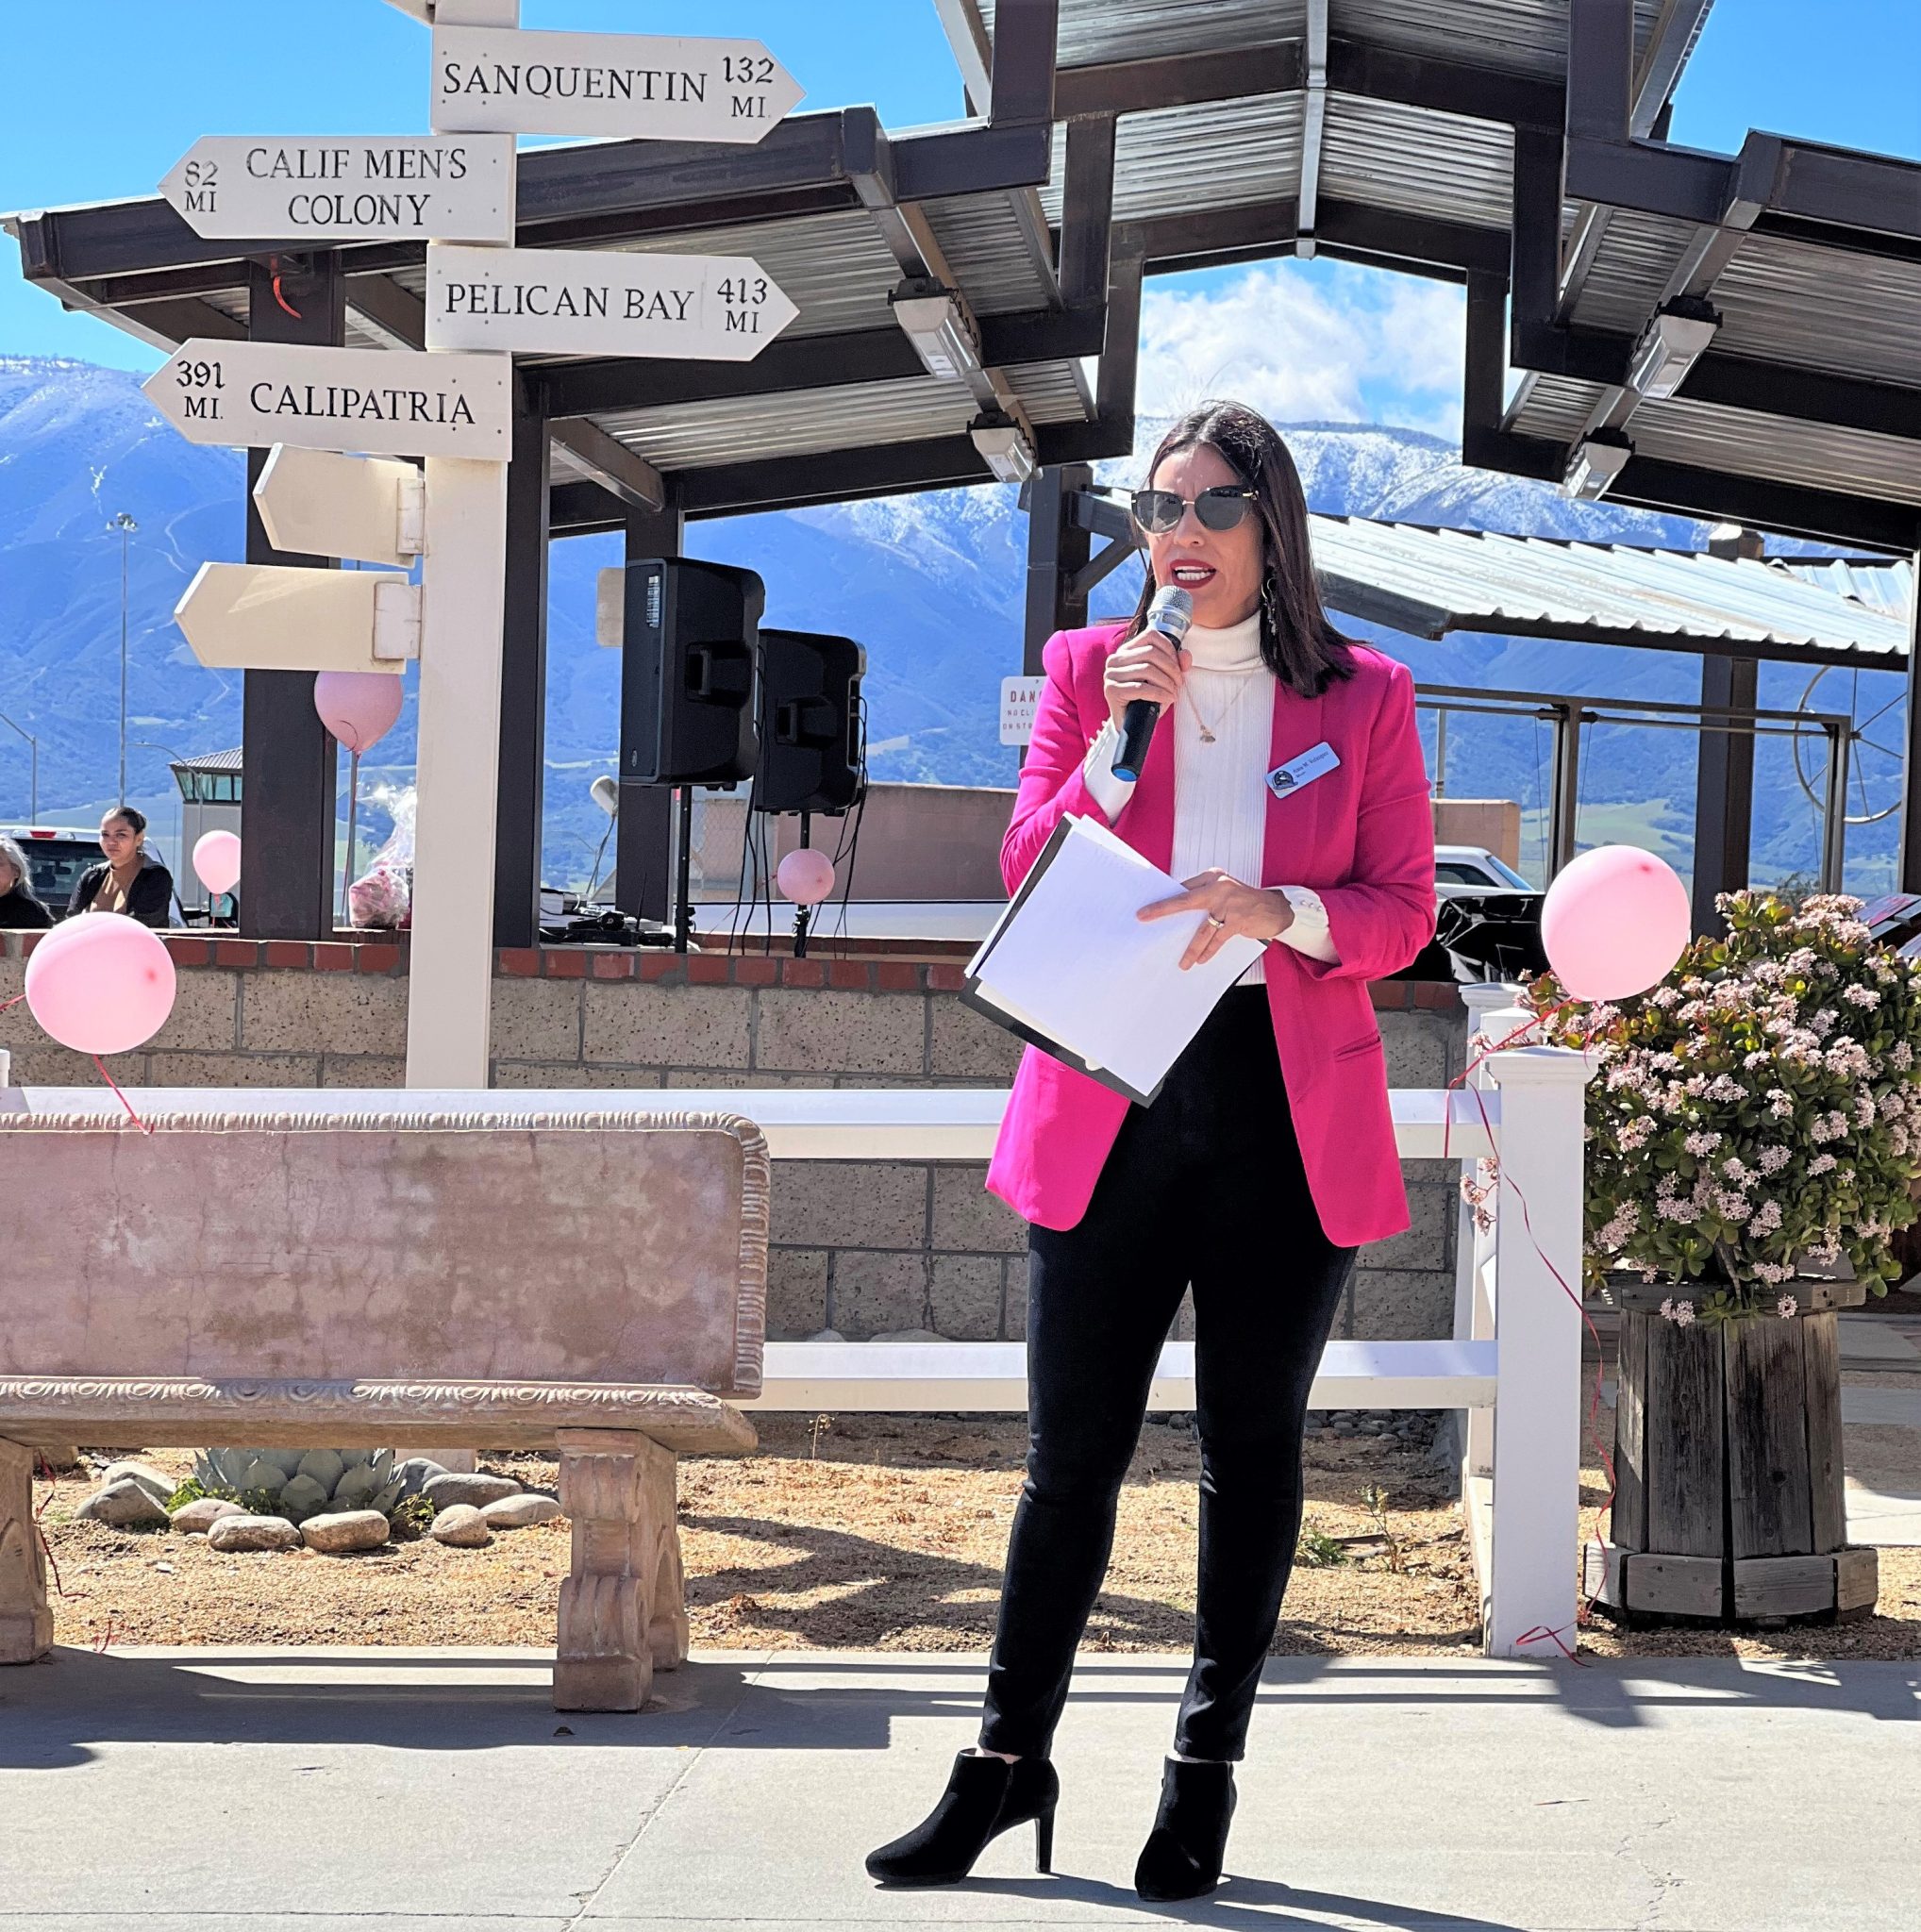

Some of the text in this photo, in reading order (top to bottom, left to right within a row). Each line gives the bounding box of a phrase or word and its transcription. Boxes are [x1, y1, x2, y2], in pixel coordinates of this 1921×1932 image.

[443, 62, 708, 103] SANQUENTIN
[722, 56, 775, 84] 132
[184, 160, 218, 187] 82
[245, 147, 467, 179] CALIF MEN'S
[184, 190, 217, 213] MI
[288, 193, 431, 225] COLONY
[445, 283, 696, 322] PELICAN BAY
[716, 277, 768, 305] 413
[175, 359, 226, 390] 391
[184, 395, 223, 420] MI.
[250, 382, 475, 425] CALIPATRIA
[1011, 691, 1042, 703] DAN
